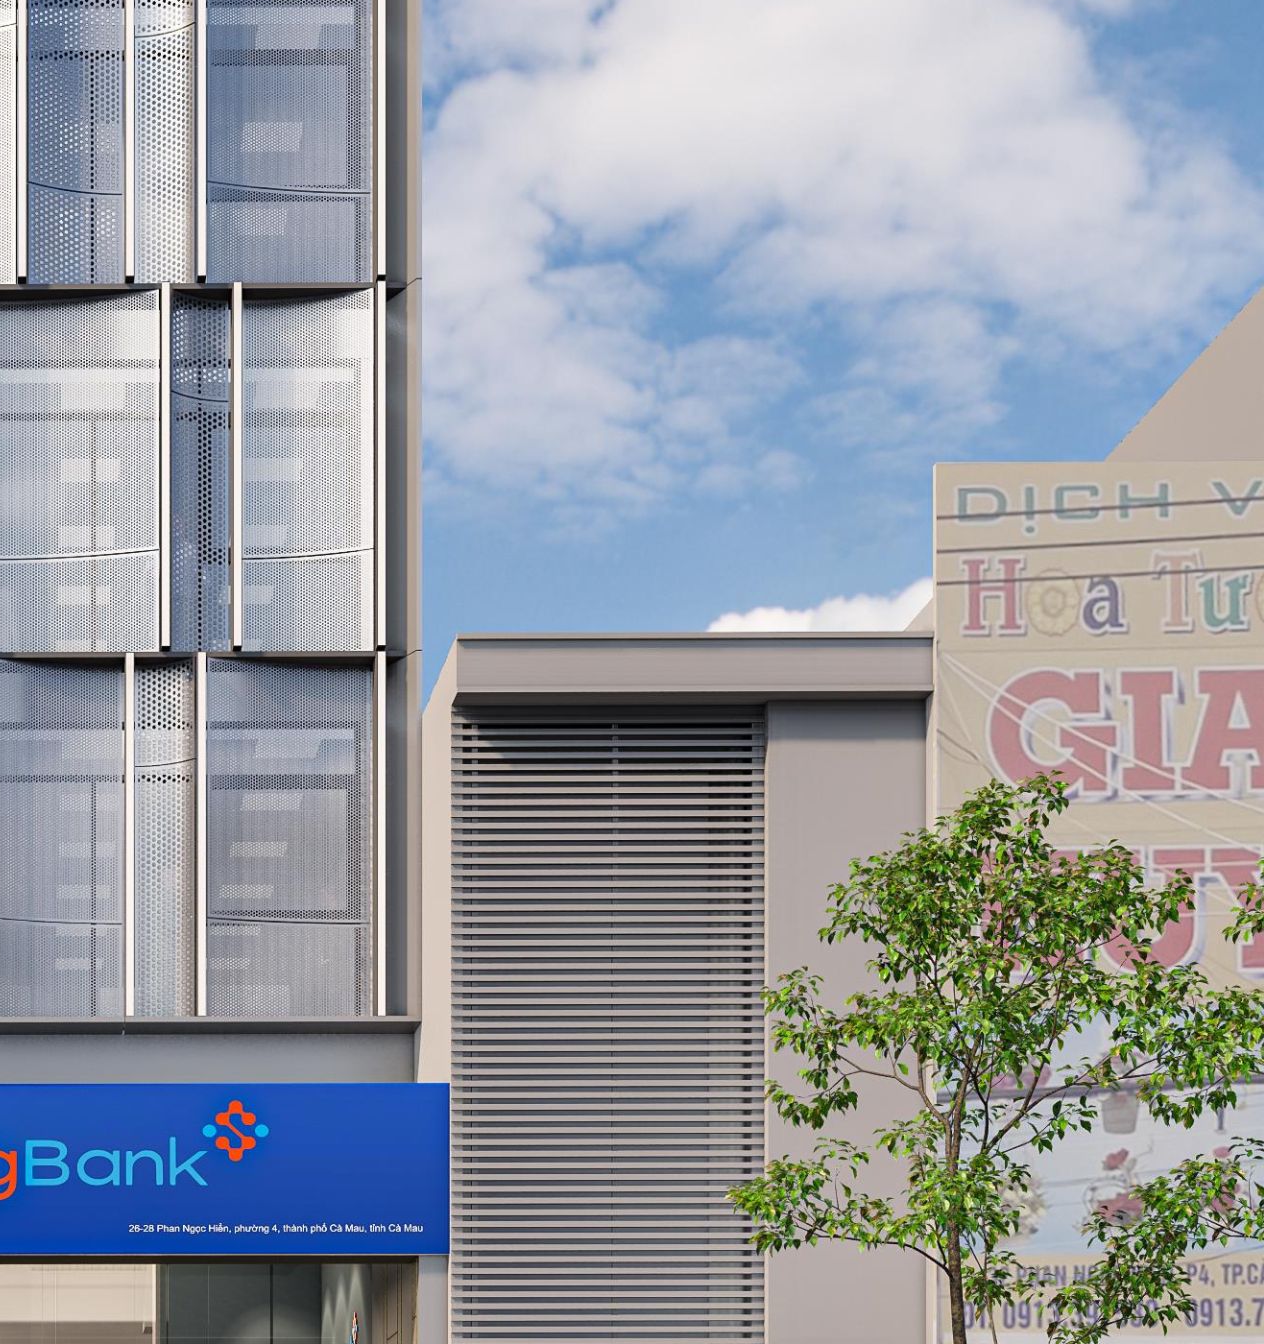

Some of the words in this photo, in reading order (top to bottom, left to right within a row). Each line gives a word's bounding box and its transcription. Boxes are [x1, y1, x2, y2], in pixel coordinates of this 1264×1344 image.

[956, 481, 1171, 534] DỊCH
[986, 666, 1264, 799] GIA
[128, 1224, 154, 1233] 26-28
[156, 1224, 180, 1233] Phan
[182, 1224, 206, 1235] Ngọc
[234, 1224, 269, 1235] phường
[283, 1224, 308, 1233] thành
[329, 1224, 343, 1233] Cà
[388, 1224, 402, 1233] Cà
[404, 1224, 424, 1233] Mau
[1187, 1263, 1215, 1287] P4,
